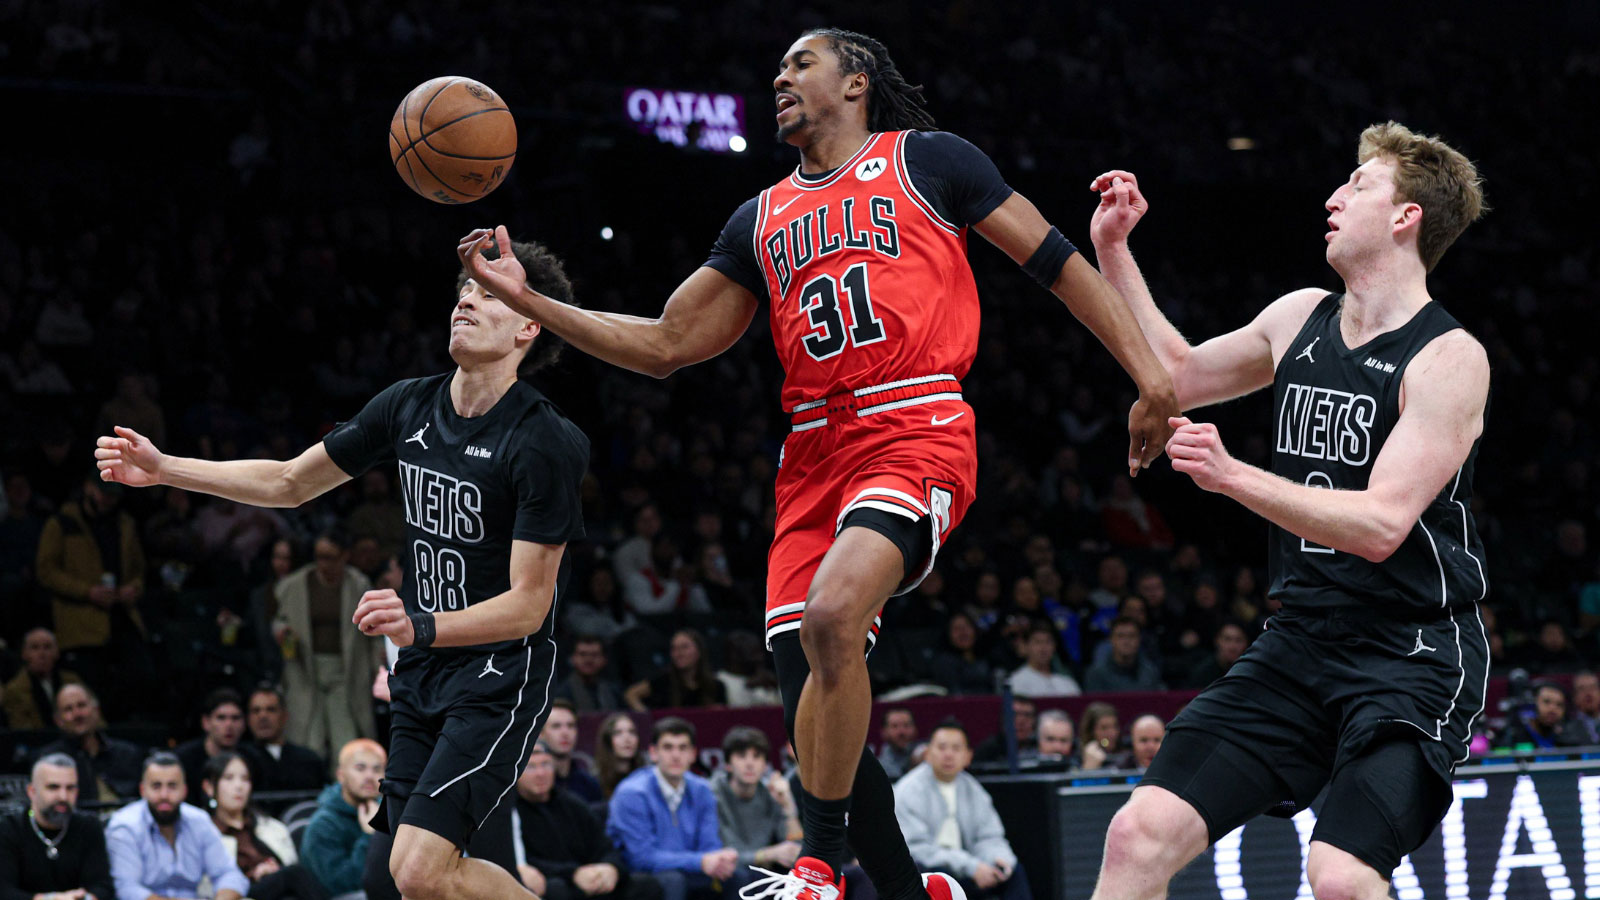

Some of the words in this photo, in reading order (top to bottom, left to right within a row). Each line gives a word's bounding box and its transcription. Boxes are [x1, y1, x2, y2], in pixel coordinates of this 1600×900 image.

[627, 89, 738, 129] QATAR
[766, 195, 900, 301] BULLS
[798, 262, 887, 362] 31
[1364, 356, 1377, 368] All
[1374, 360, 1384, 371] In
[1383, 362, 1397, 374] Wo
[464, 445, 475, 456] All
[1276, 383, 1377, 467] NETS
[398, 459, 485, 544] NETS
[413, 539, 468, 613] 88
